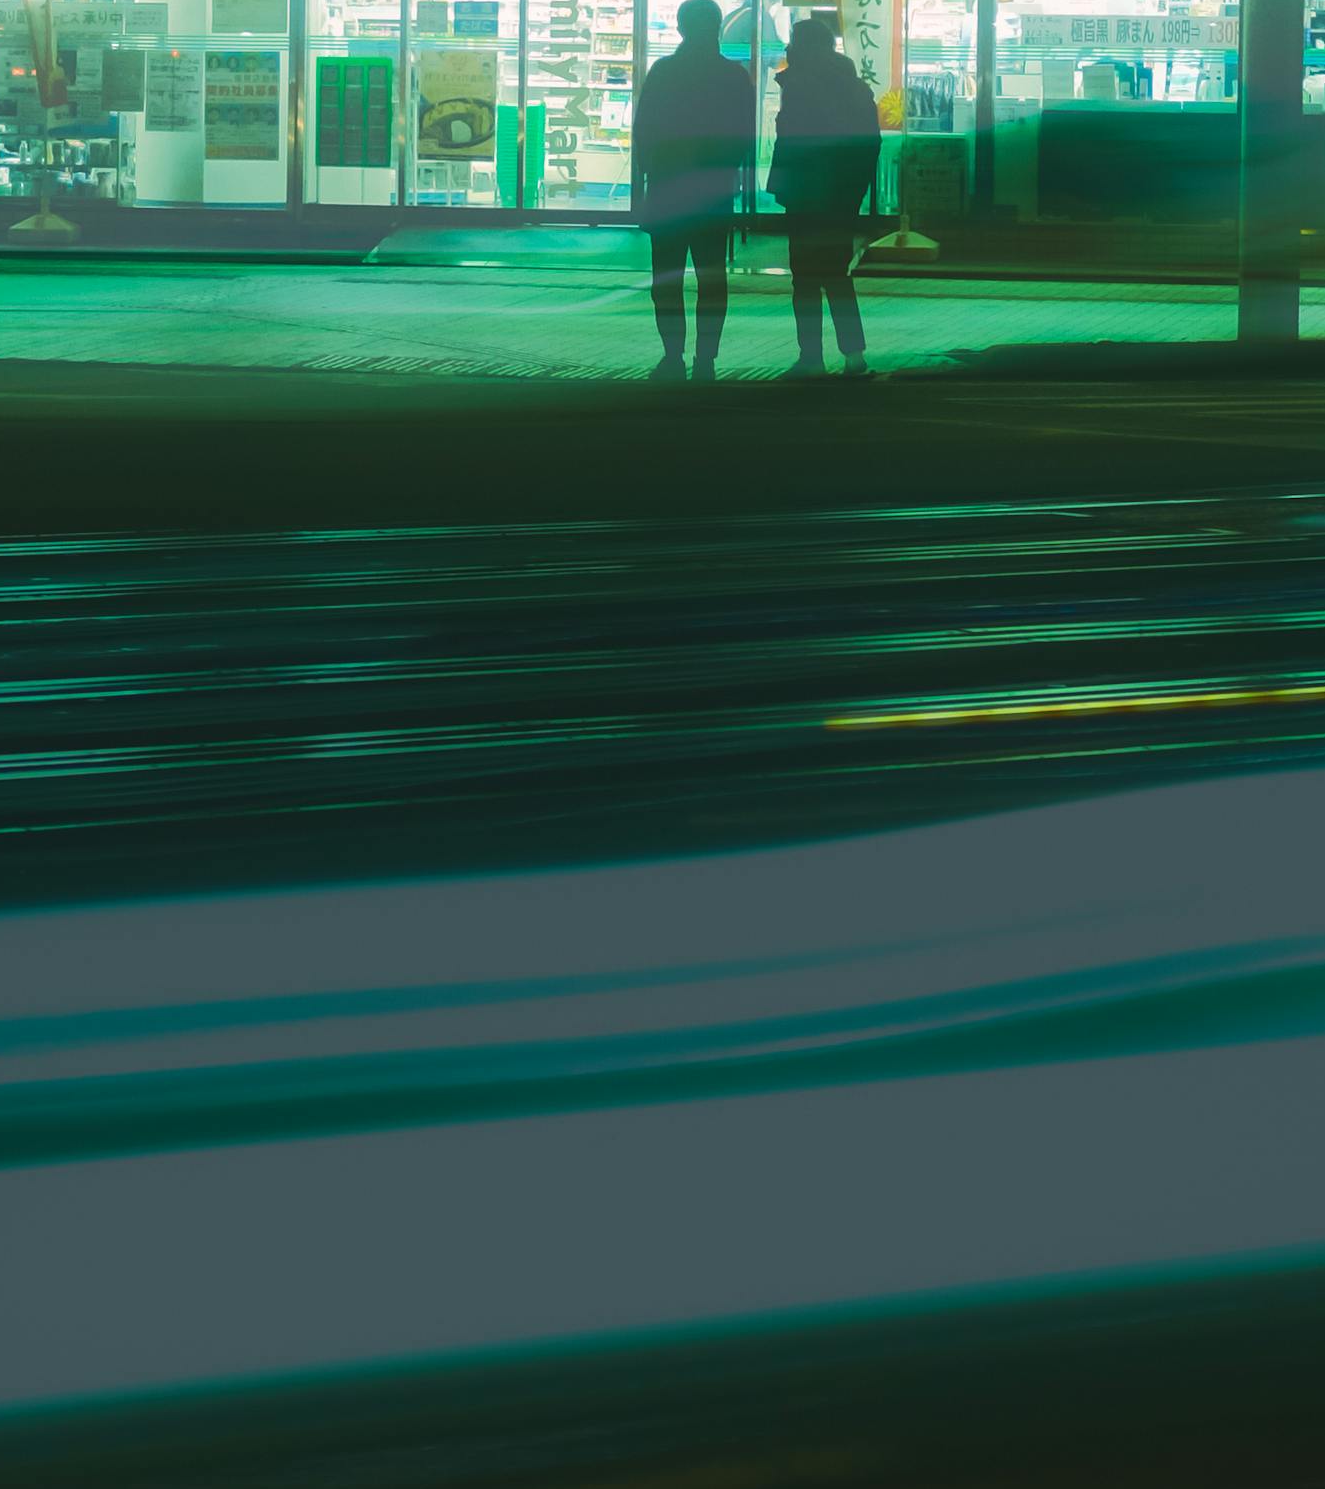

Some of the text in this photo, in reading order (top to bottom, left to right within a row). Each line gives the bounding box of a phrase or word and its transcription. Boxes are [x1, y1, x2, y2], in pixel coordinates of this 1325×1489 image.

[1116, 18, 1154, 44] 豚まん
[1209, 21, 1240, 44] 130
